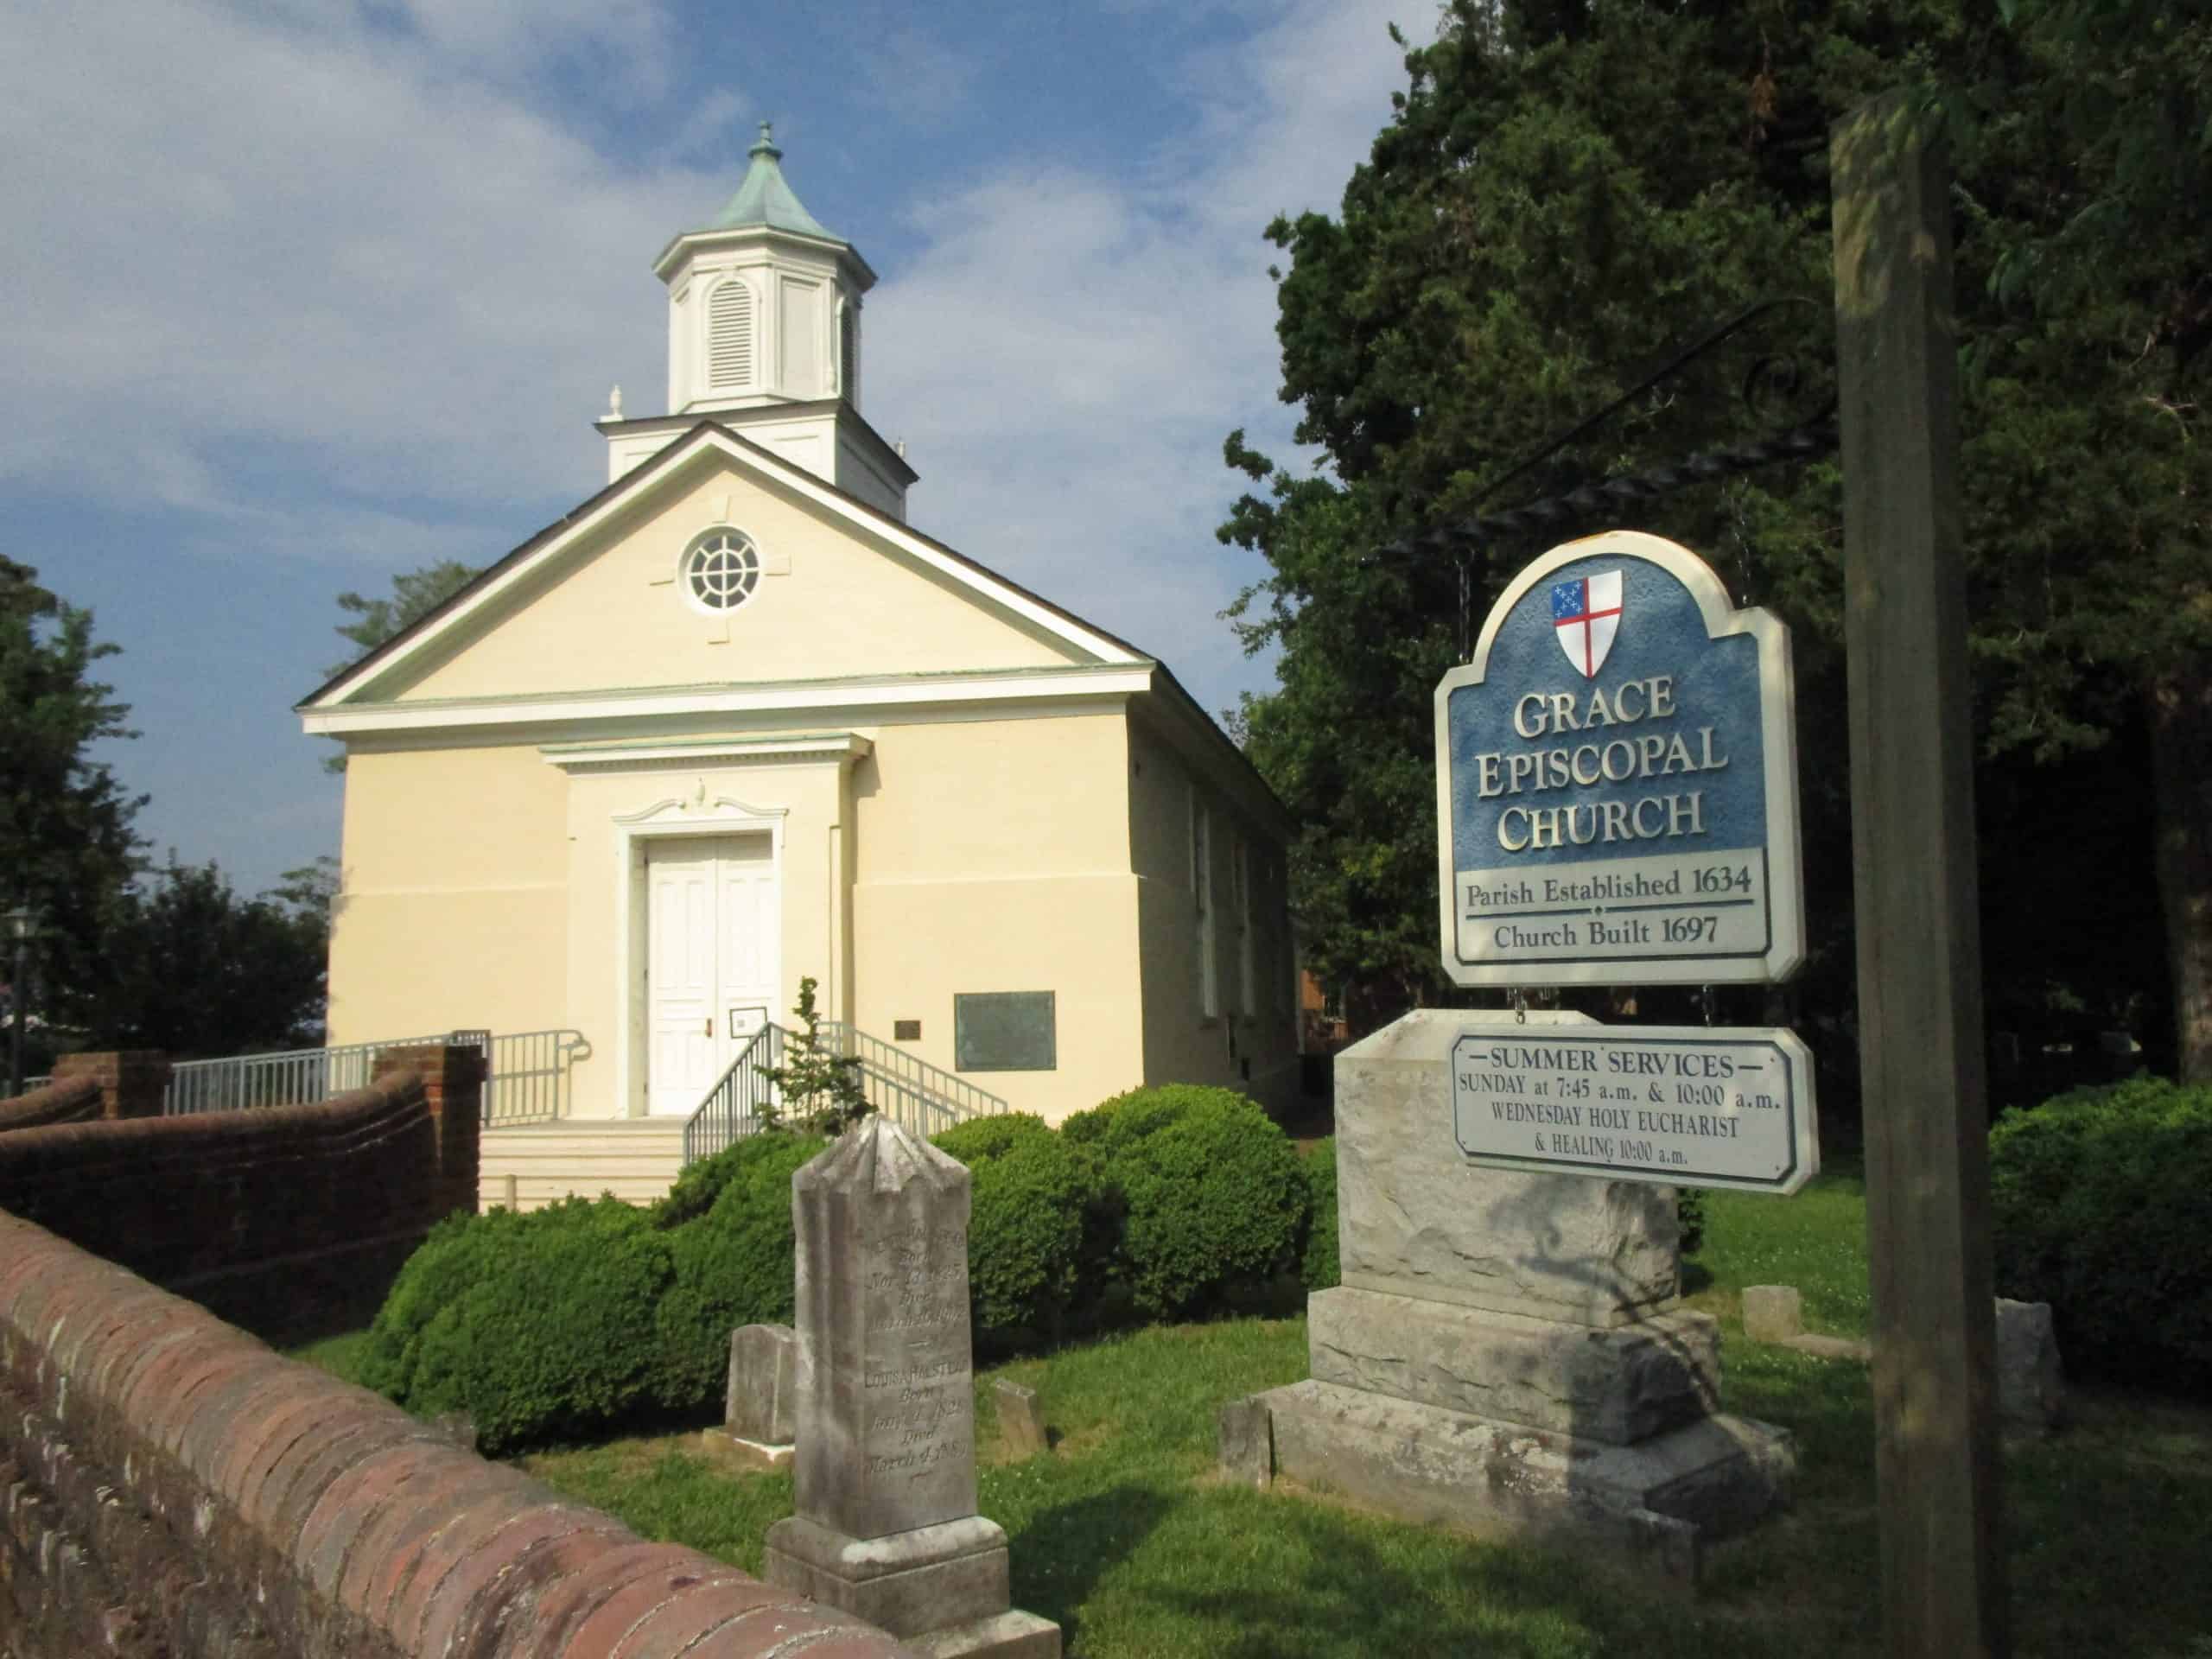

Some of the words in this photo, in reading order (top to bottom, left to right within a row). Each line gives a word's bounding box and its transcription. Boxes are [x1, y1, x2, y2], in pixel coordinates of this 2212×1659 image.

[1514, 675, 1675, 739] GRACE
[1475, 726, 1729, 798] EPISCOPAL
[1497, 791, 1706, 851] CHURCH
[1465, 880, 1535, 907] Parish
[1543, 869, 1681, 903] Established
[1693, 865, 1752, 894] 1634
[1494, 922, 1577, 949] Church
[1589, 918, 1650, 945] Built
[1662, 916, 1719, 943] 1697
[1458, 1072, 1527, 1094] SUNDAY
[1534, 1080, 1548, 1096] at
[1557, 1077, 1590, 1099] 7:45
[1599, 1085, 1637, 1101] a.m.
[1648, 1081, 1665, 1103] &
[1676, 1084, 1725, 1105] 10:00
[1735, 1092, 1780, 1109] a.m.
[1491, 1101, 1581, 1126] WEDNESDAY
[1589, 1107, 1630, 1130] HOLY
[1637, 1110, 1739, 1138] EUCHARIST
[1534, 1132, 1547, 1152] &
[1552, 1133, 1614, 1158] HEALING
[1619, 1139, 1652, 1161] 10:00
[1658, 1148, 1688, 1165] a.m.
